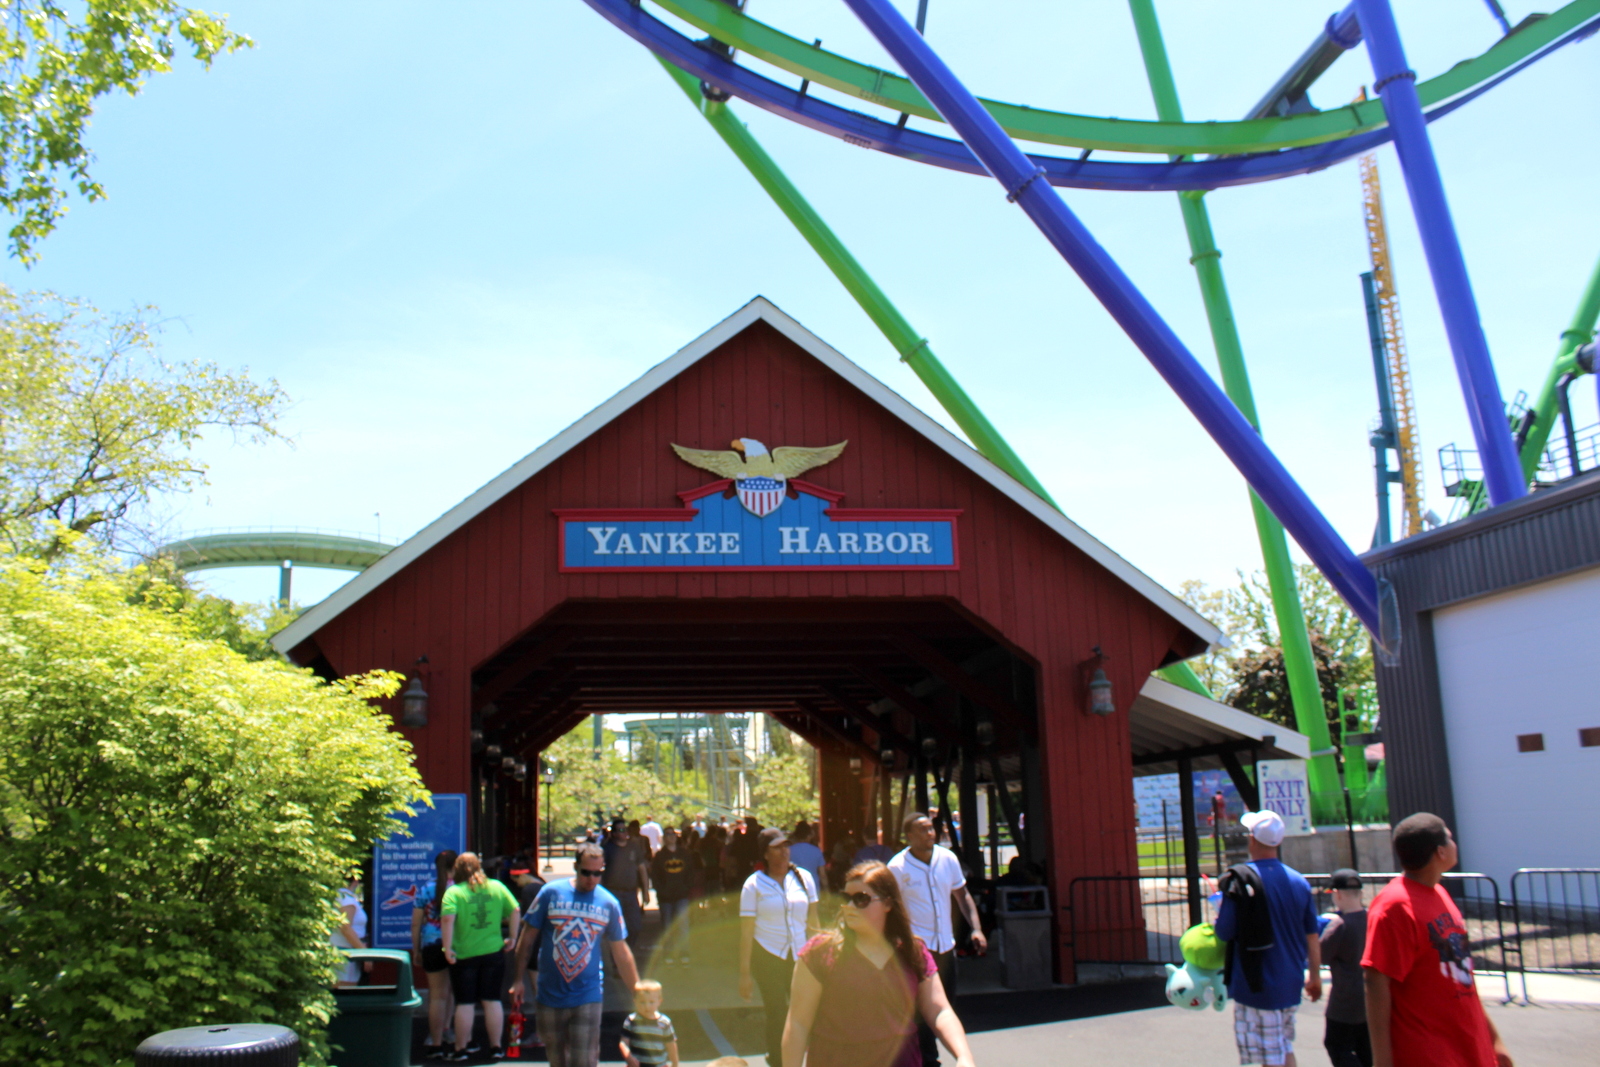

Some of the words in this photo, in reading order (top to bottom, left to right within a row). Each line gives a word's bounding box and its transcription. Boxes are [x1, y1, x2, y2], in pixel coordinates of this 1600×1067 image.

[587, 527, 740, 555] YANKEE
[779, 526, 932, 554] HARBOR
[1263, 780, 1304, 798] EXIT
[1264, 799, 1306, 816] ONLY
[401, 841, 434, 851] walking
[382, 852, 391, 860] to
[393, 852, 407, 860] the
[408, 852, 427, 860] next
[382, 862, 399, 870] ride
[400, 862, 429, 870] counts
[382, 872, 416, 882] working
[548, 901, 610, 917] AMERICAN
